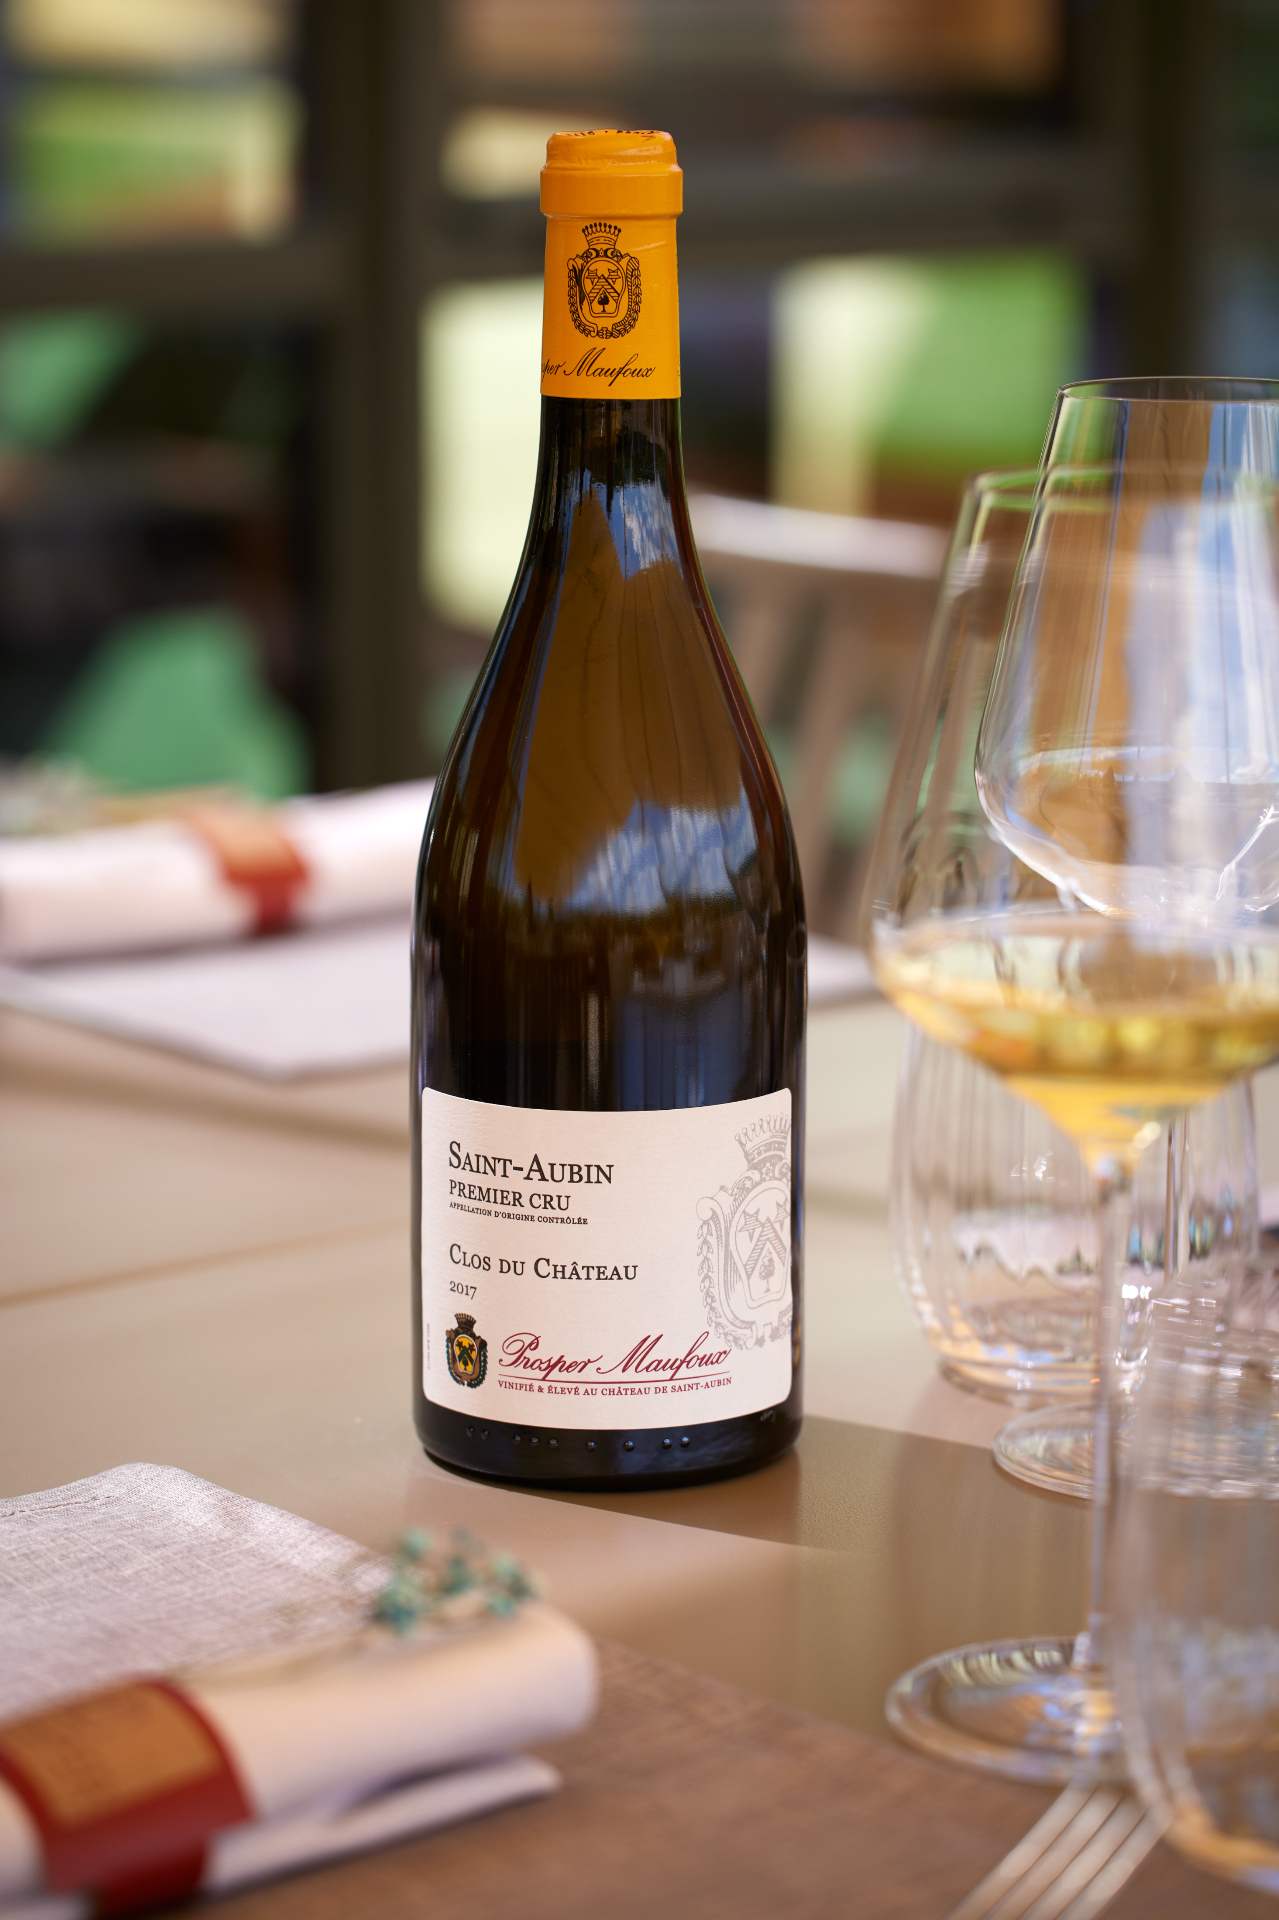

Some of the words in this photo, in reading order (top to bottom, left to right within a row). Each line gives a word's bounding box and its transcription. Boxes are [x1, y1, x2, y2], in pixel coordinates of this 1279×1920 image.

[563, 347, 656, 386] Maufoux
[449, 1141, 614, 1184] SAINT-AUBIN
[449, 1179, 525, 1207] PREMIER
[529, 1193, 571, 1211] CRU
[450, 1201, 492, 1217] APPELLATION
[494, 1210, 535, 1222] D'ORIGINE
[537, 1215, 588, 1225] CONTRÔLÉE
[450, 1243, 491, 1271] CLOS
[499, 1259, 525, 1276] DU
[534, 1257, 638, 1280] CHÂTEAU
[450, 1280, 477, 1300] 2017
[499, 1332, 603, 1380] Prosper
[596, 1331, 732, 1380] Maufoux
[498, 1379, 535, 1393] VINIFIÉ
[538, 1385, 545, 1393] &
[547, 1384, 580, 1396] ÉLEVÉ
[583, 1387, 598, 1396] AU
[601, 1386, 651, 1396] CHÂTEAU
[654, 1385, 668, 1394] DE
[671, 1377, 732, 1393] SAINT-AUBIN
